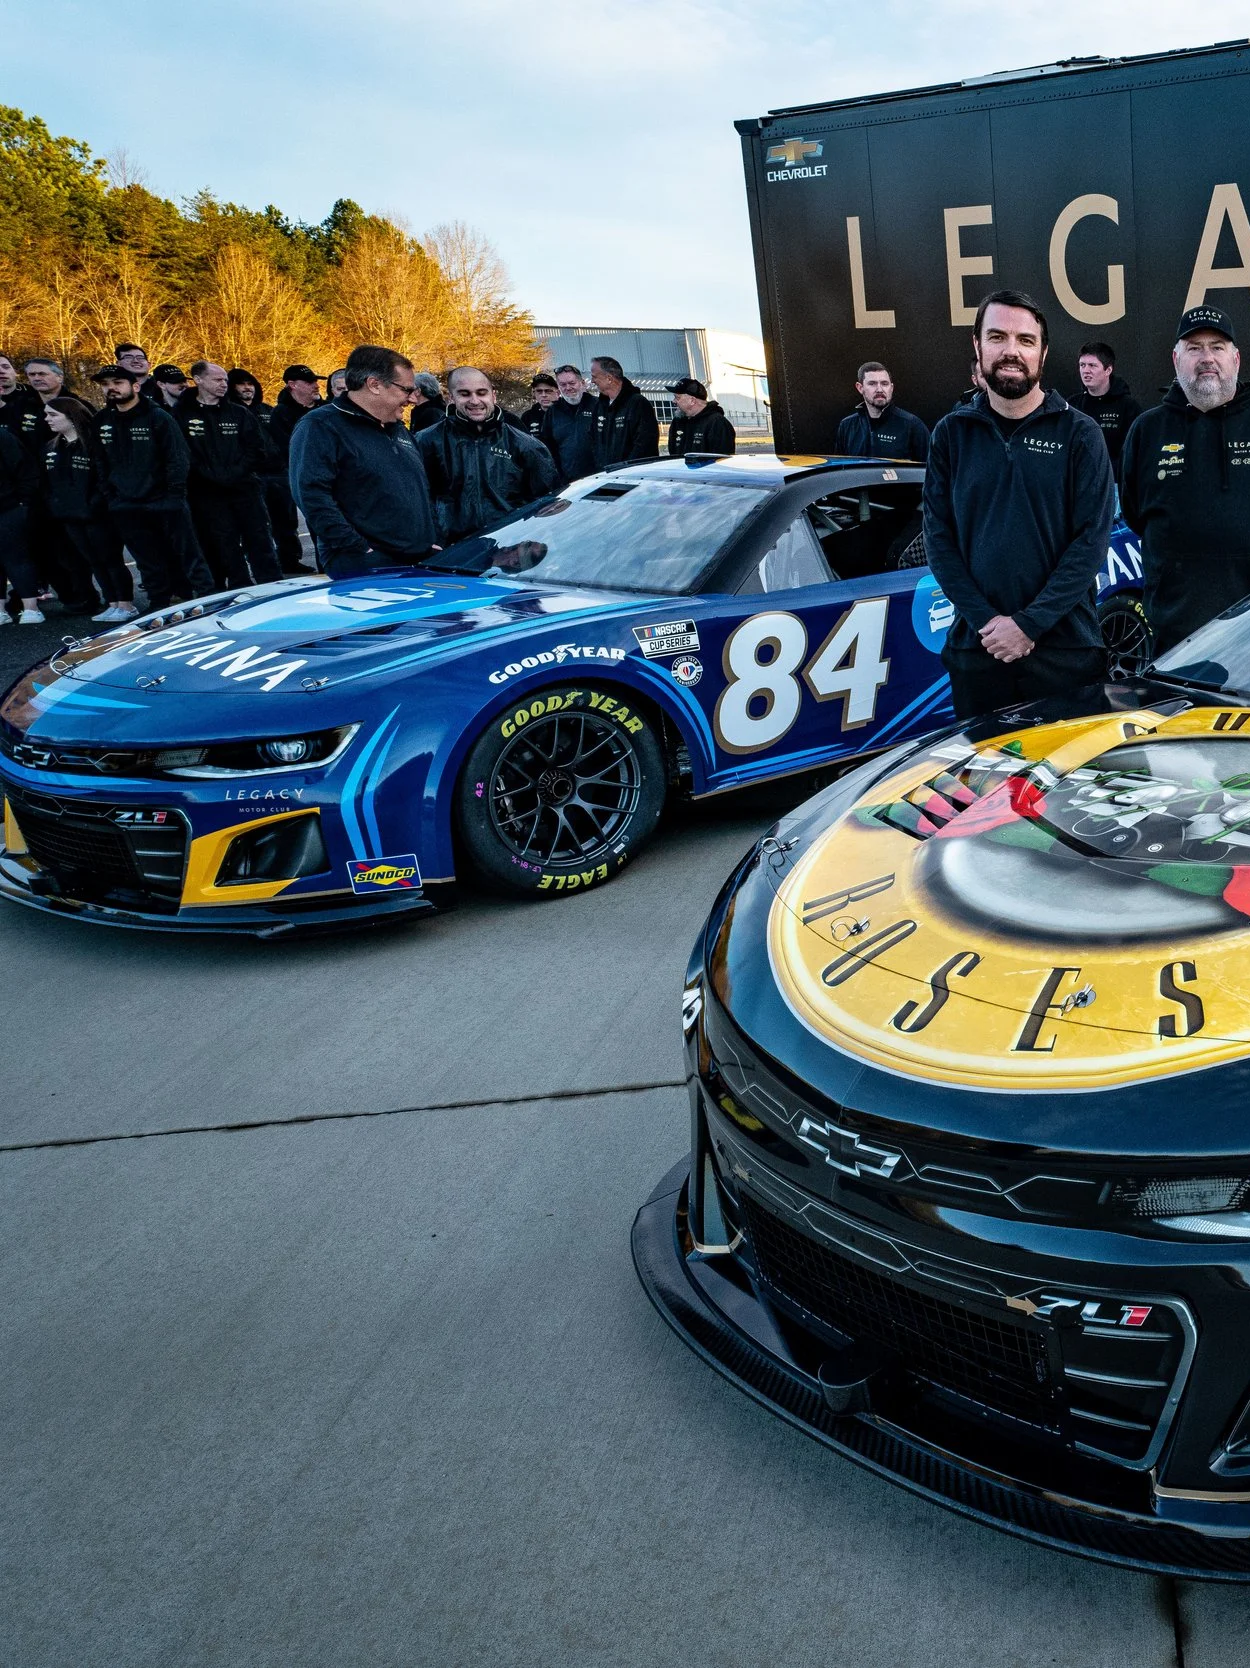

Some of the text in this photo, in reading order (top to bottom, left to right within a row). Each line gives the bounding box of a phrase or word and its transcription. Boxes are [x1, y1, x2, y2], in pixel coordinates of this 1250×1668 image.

[767, 165, 828, 182] CHEVROLET
[1188, 310, 1222, 319] LEGACY
[1023, 437, 1064, 449] LEGACY
[655, 623, 687, 636] NASCAR
[650, 636, 691, 651] CUP SERIES
[488, 644, 626, 684] GOODYEAR
[716, 598, 889, 752] 84
[225, 788, 305, 800] LEGACY
[115, 811, 168, 823] ZL1
[356, 868, 413, 882] SUNOCO
[536, 863, 608, 890] EAGLE
[802, 872, 1206, 1053] ROSES
